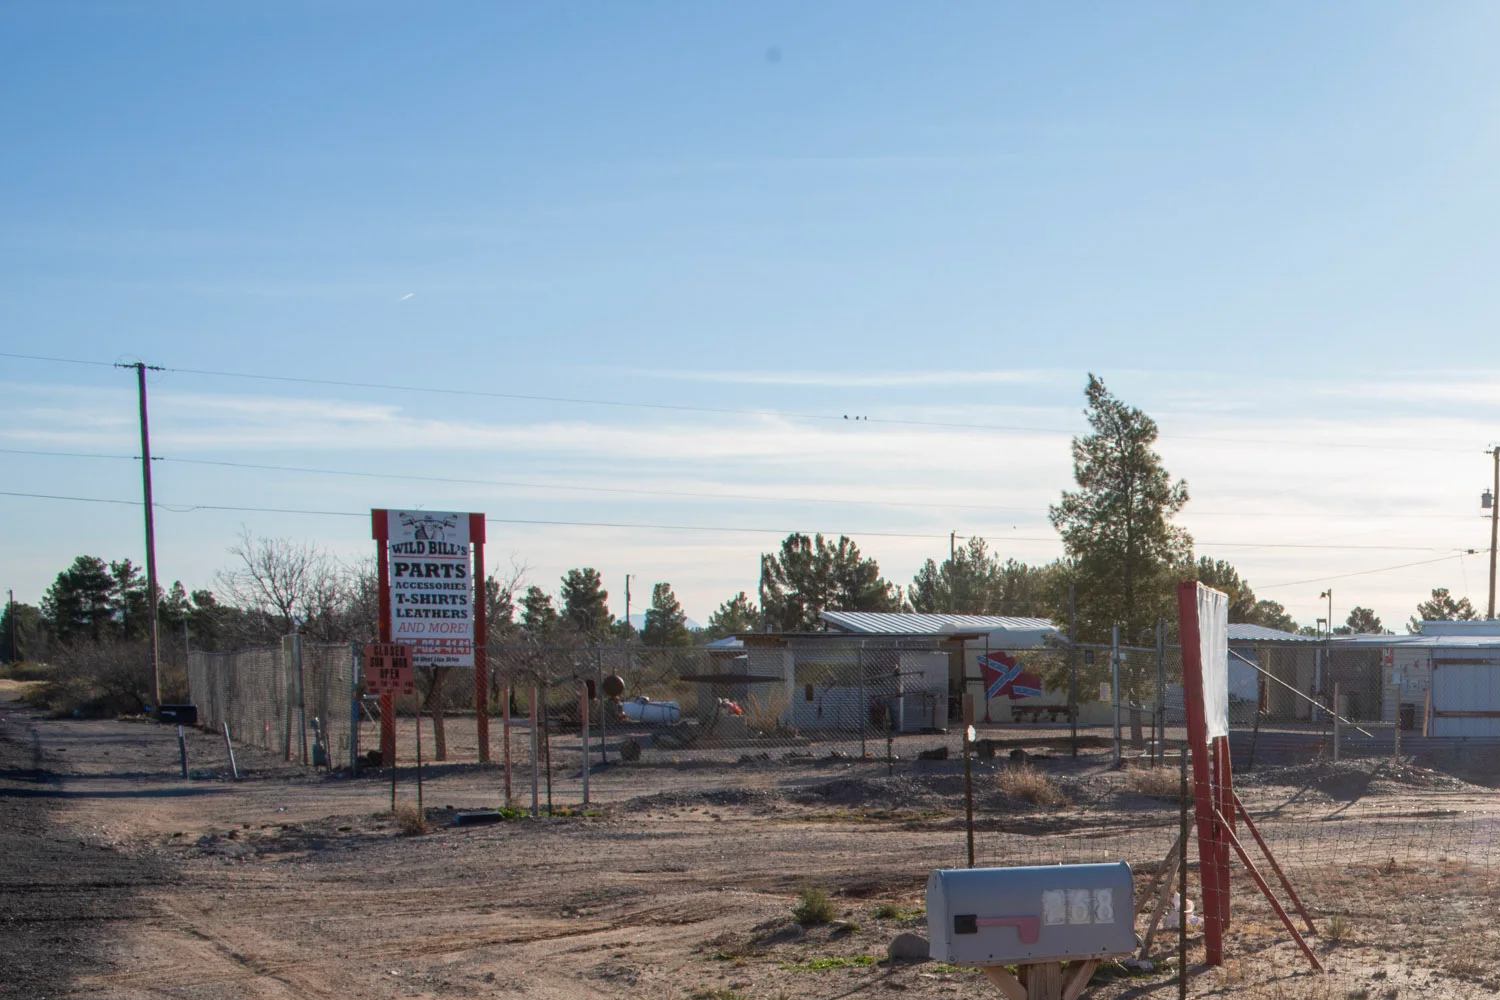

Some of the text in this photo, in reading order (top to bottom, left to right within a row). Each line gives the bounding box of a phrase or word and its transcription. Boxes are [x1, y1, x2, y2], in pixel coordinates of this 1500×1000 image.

[392, 541, 467, 556] WILD BILL'S
[394, 562, 467, 578] PARTS
[395, 582, 467, 590] ACCESSORIES
[395, 593, 468, 605] T-SHIRTS
[396, 608, 468, 619] LEATHERS
[398, 622, 469, 634] AND MORE!
[374, 646, 405, 656] CLOSED
[380, 669, 399, 679] OPEN
